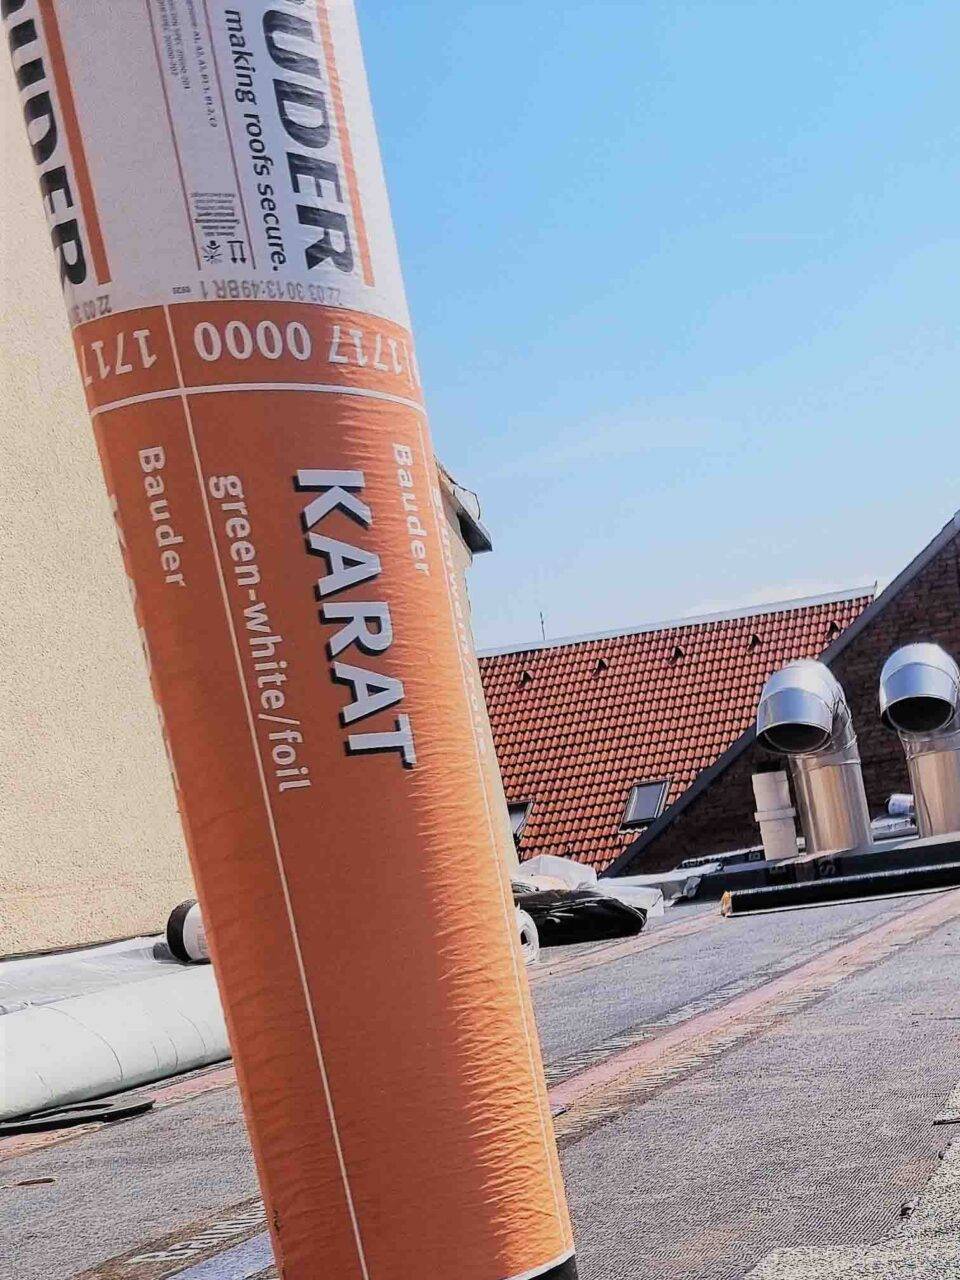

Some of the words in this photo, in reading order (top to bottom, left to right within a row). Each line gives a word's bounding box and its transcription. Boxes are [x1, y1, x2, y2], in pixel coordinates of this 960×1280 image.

[1, 0, 86, 285] UDER
[225, 10, 257, 105] making
[243, 113, 273, 176] roofs
[258, 182, 287, 272] secure.
[262, 0, 354, 272] UDER
[193, 320, 311, 361] 0000
[138, 445, 187, 588] Bauder
[209, 472, 312, 793] green-white/foil
[293, 469, 418, 770] KARAT
[392, 442, 432, 577] Bauder
